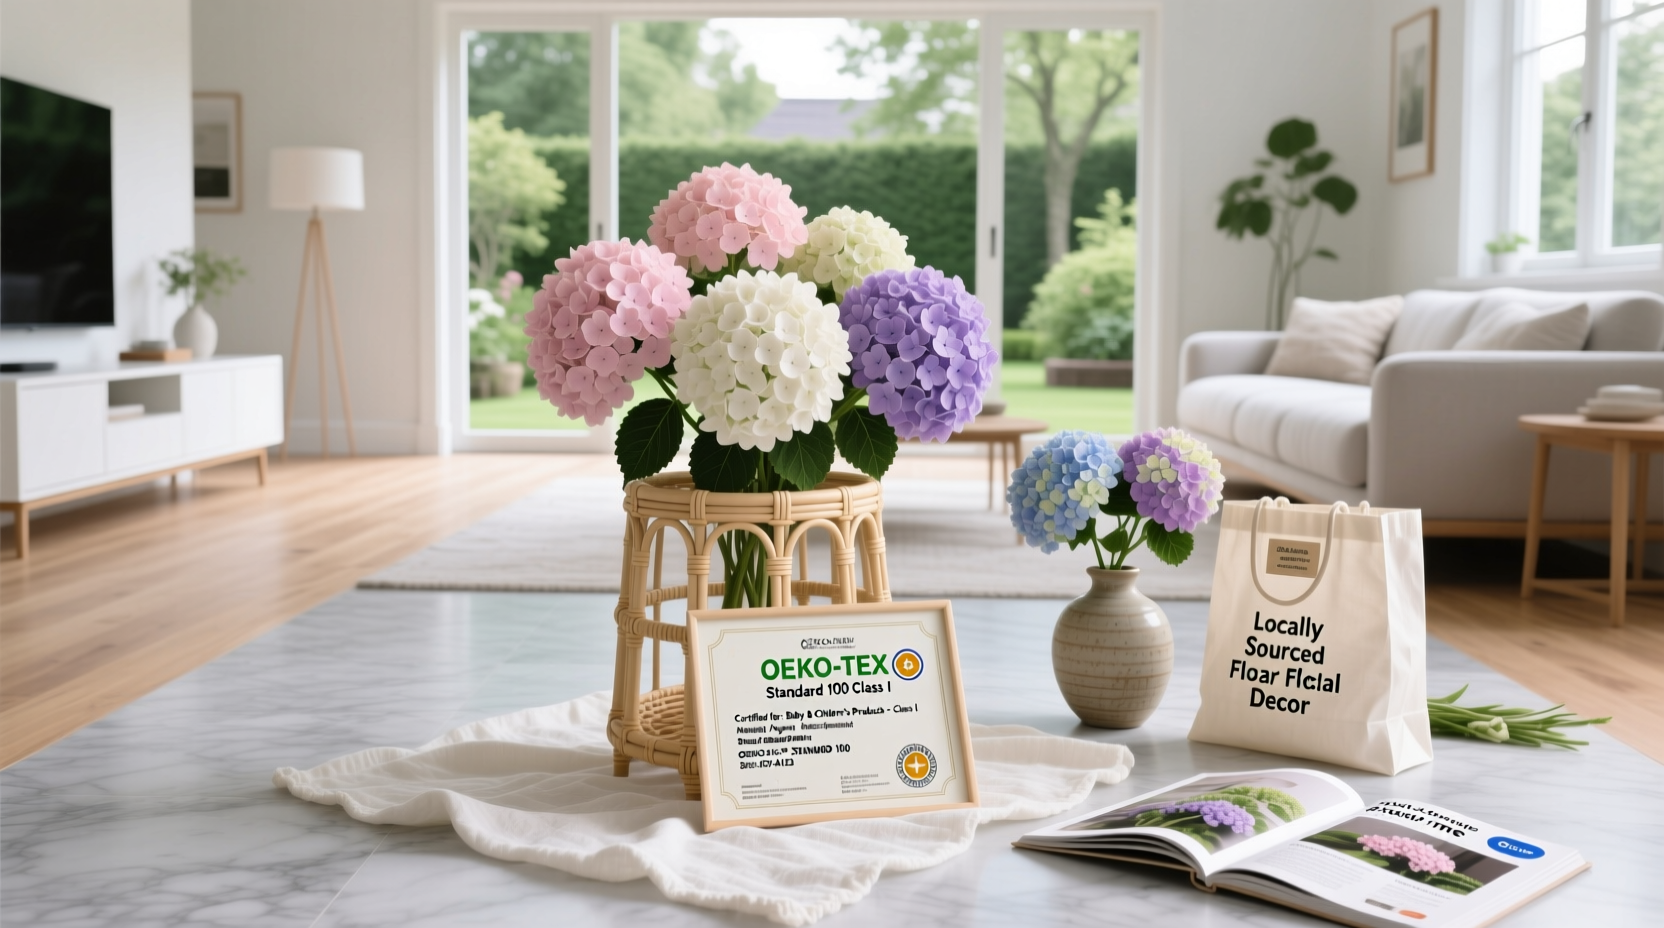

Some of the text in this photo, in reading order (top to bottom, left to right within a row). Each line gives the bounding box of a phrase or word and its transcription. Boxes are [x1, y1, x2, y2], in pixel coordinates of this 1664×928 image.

[1253, 611, 1324, 643] Locally
[1244, 636, 1325, 665] Sourced
[761, 654, 889, 681] OEKO-TEX
[1229, 659, 1280, 685] Floar
[766, 683, 824, 699] Standard
[827, 682, 849, 695] 100
[852, 681, 884, 694] Class
[1249, 687, 1311, 715] Decor
[835, 743, 851, 753] 100
